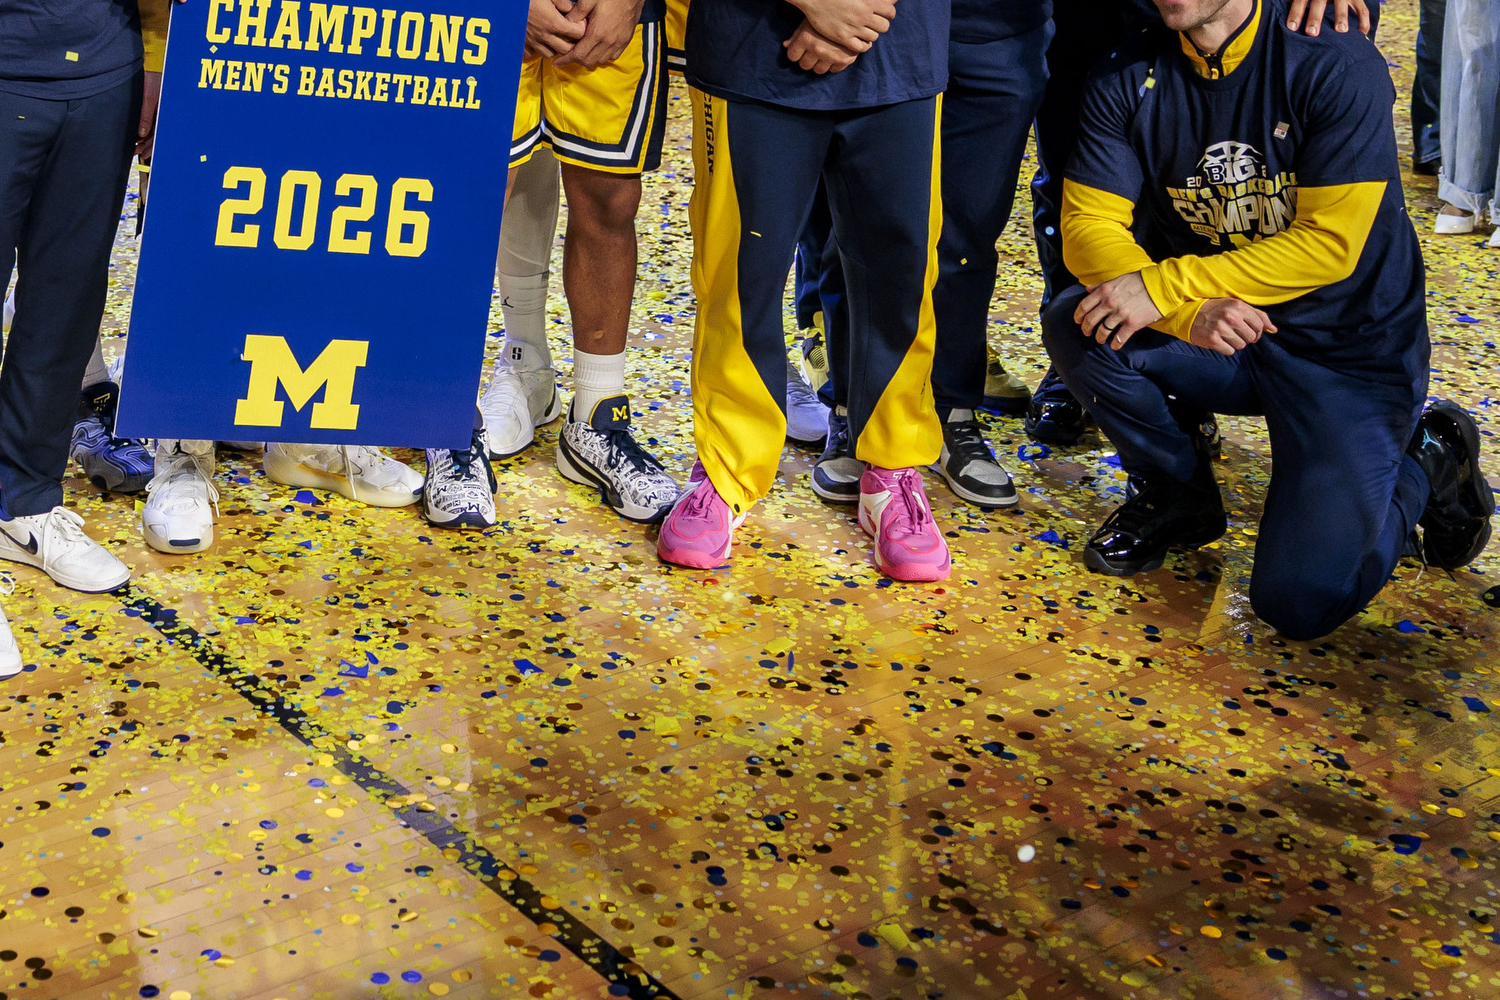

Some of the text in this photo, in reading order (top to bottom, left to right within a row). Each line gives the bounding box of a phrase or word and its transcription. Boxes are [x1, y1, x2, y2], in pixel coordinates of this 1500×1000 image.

[197, 58, 482, 111] MEN'S BASKETBALL
[1186, 175, 1203, 188] 20
[214, 165, 435, 258] 2026
[1173, 185, 1297, 235] CHAMPION
[233, 333, 370, 430] M
[611, 404, 629, 422] M
